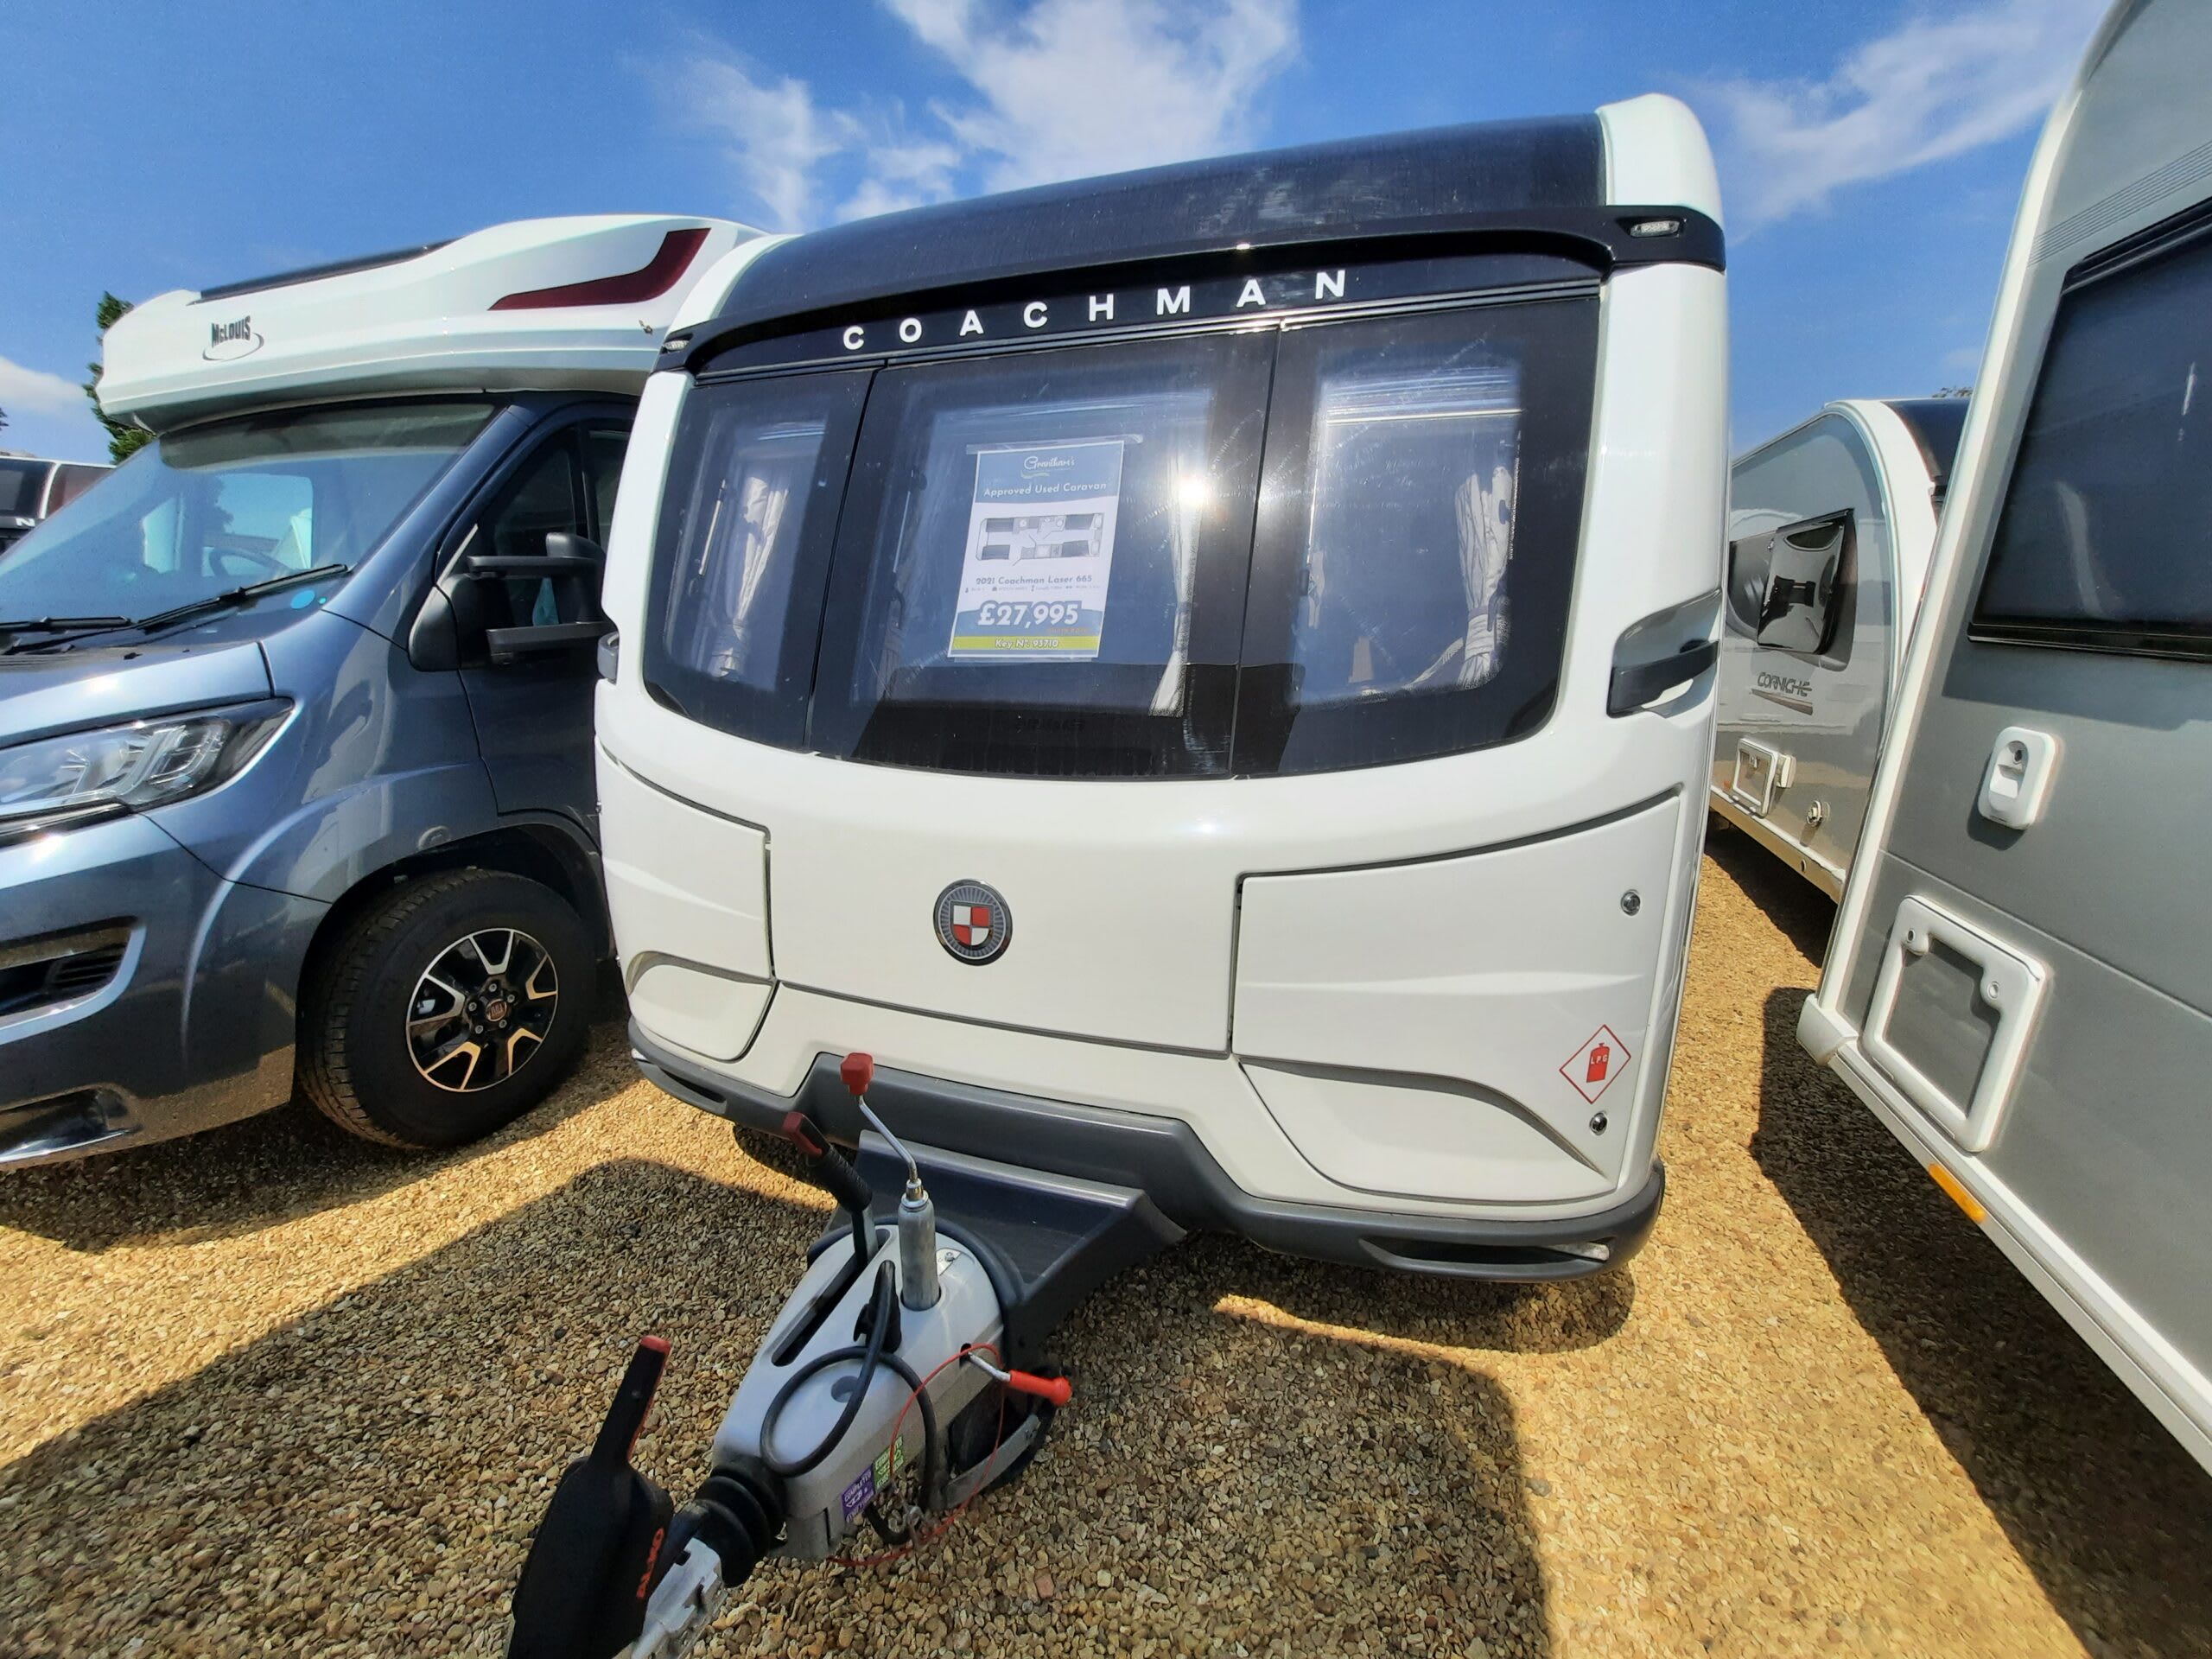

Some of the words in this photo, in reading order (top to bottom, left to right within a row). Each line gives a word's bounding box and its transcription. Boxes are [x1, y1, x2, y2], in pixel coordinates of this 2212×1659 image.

[842, 269, 1347, 351] COACHMAN
[983, 485, 1032, 498] Approved
[1035, 483, 1060, 493] Used
[1063, 482, 1107, 493] Caravan
[998, 575, 1045, 585] Coachman
[1047, 575, 1073, 584] Laser
[977, 602, 1079, 629] £27,995
[995, 639, 1014, 649] Key
